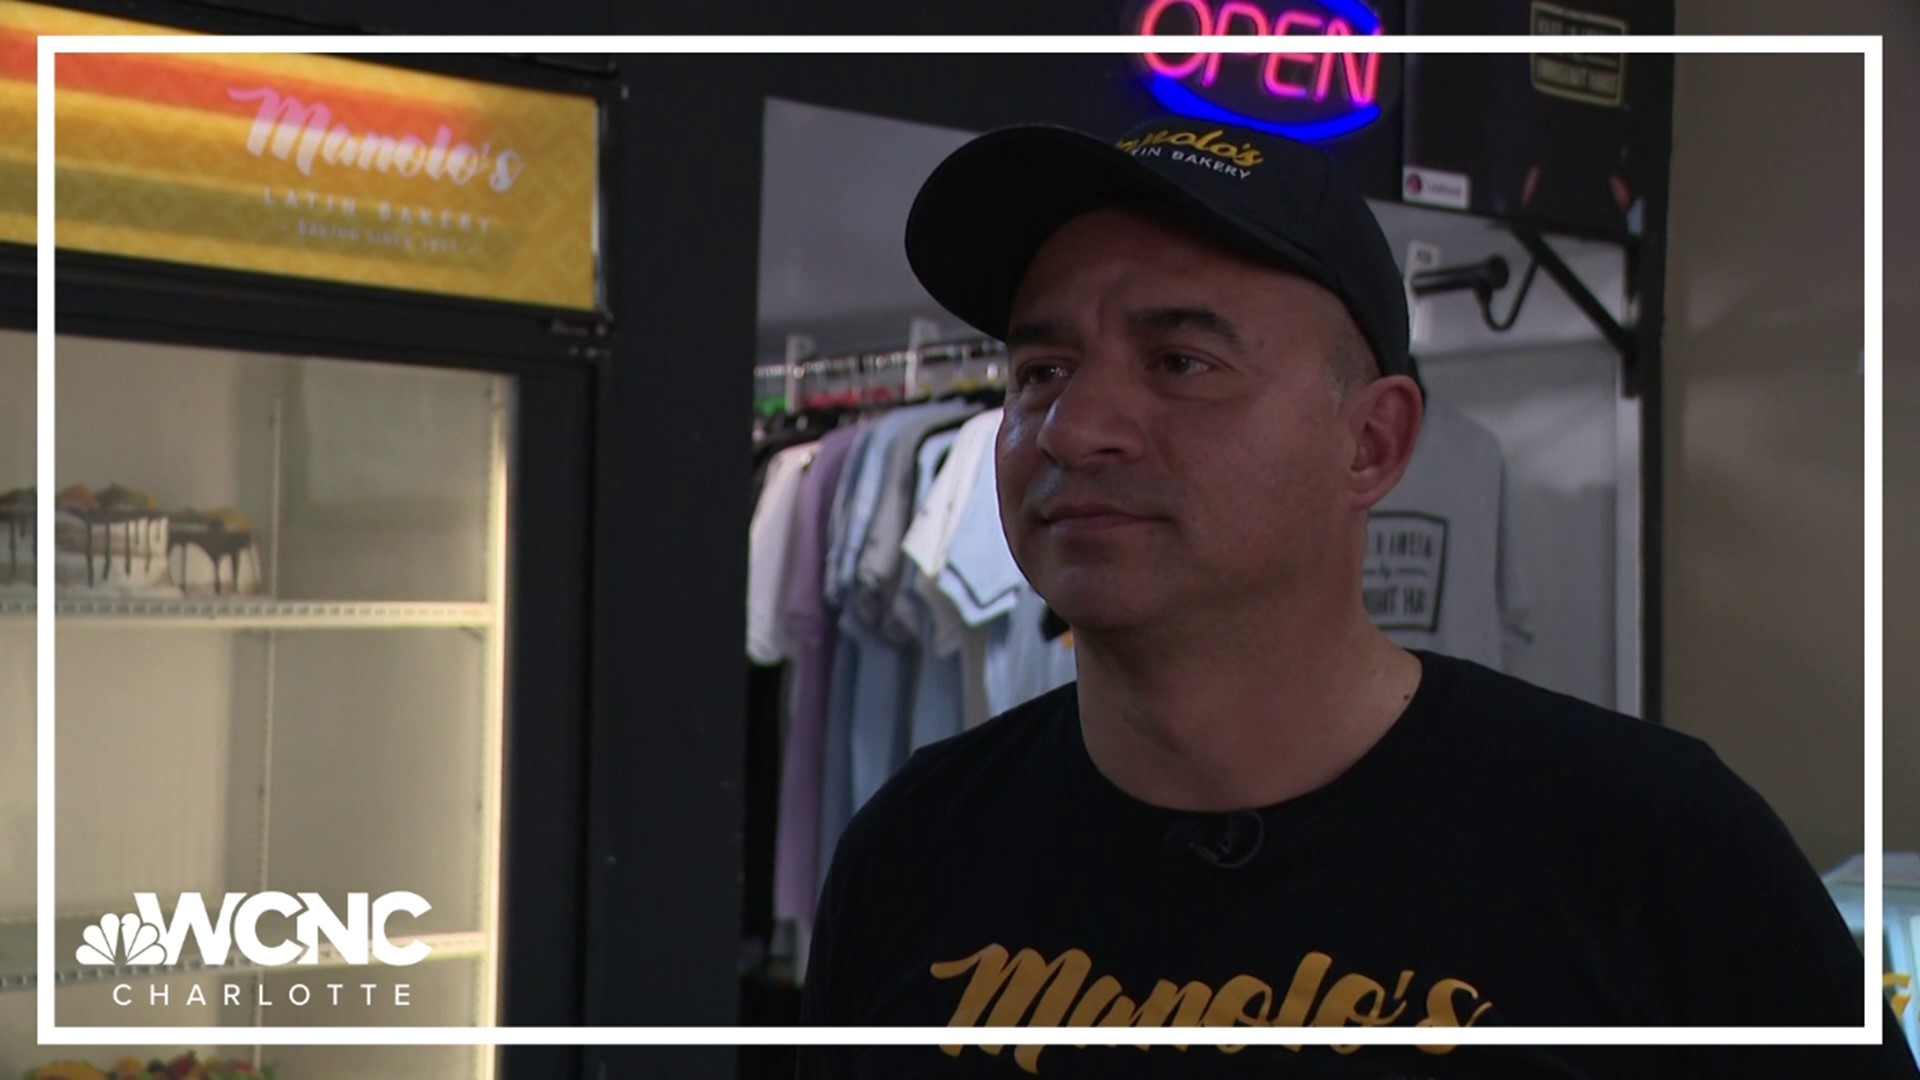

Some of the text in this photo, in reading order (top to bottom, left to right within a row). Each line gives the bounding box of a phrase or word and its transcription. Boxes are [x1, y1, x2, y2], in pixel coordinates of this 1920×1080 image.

[1140, 0, 1383, 107] OPEN
[227, 86, 525, 192] Manolo's
[1171, 149, 1251, 181] BAKERY
[262, 185, 492, 233] LATIN BAKERY
[930, 943, 1493, 1074] Manolo's
